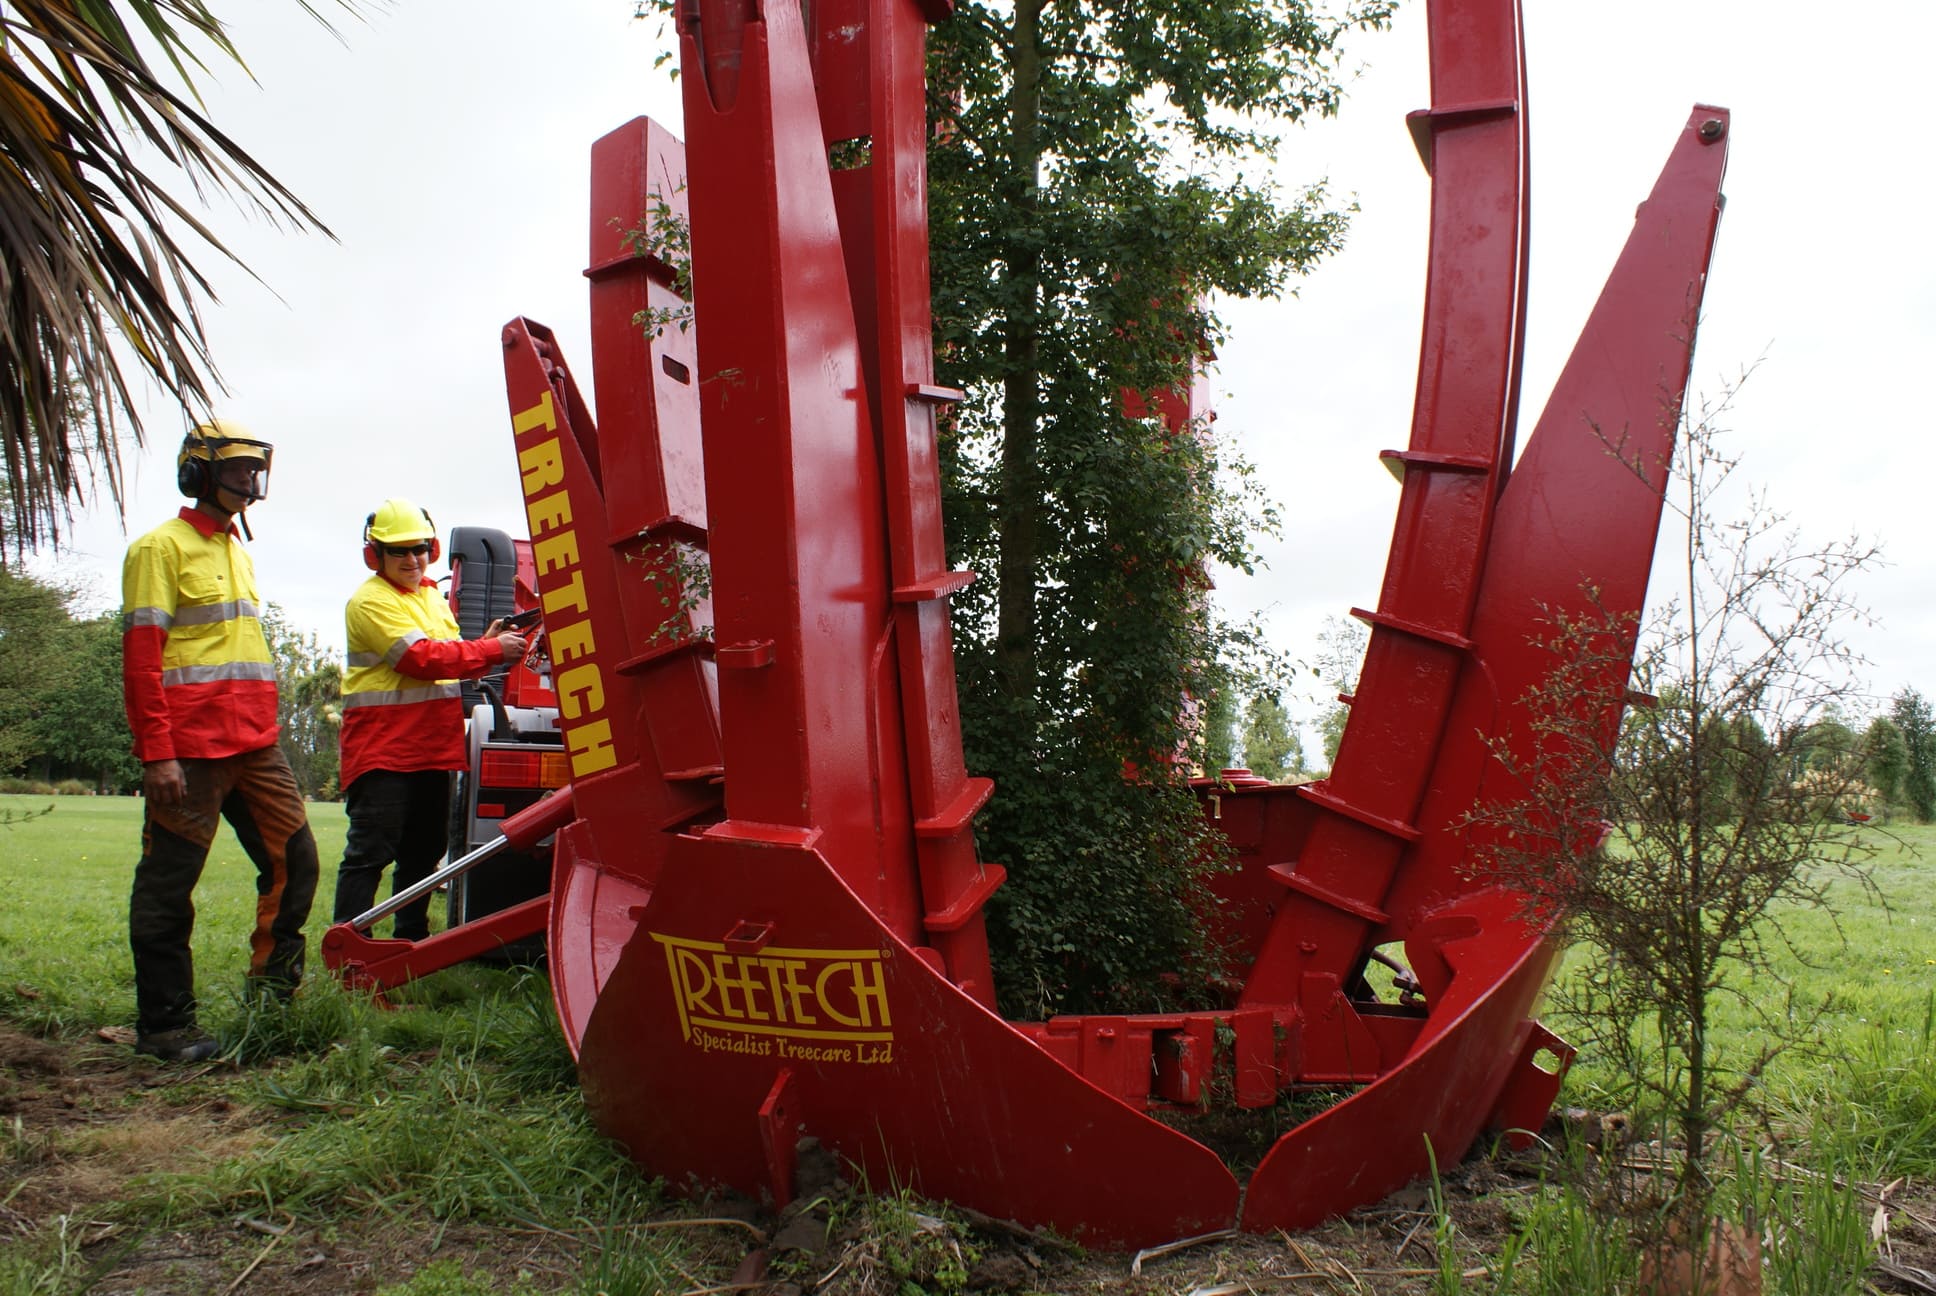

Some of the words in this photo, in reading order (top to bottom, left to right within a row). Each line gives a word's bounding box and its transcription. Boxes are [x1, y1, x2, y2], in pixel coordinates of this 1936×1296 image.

[513, 390, 617, 777] TREETECH
[692, 1026, 771, 1056] Specialist
[776, 1037, 852, 1062] Treecare
[856, 1042, 894, 1064] Ltd
